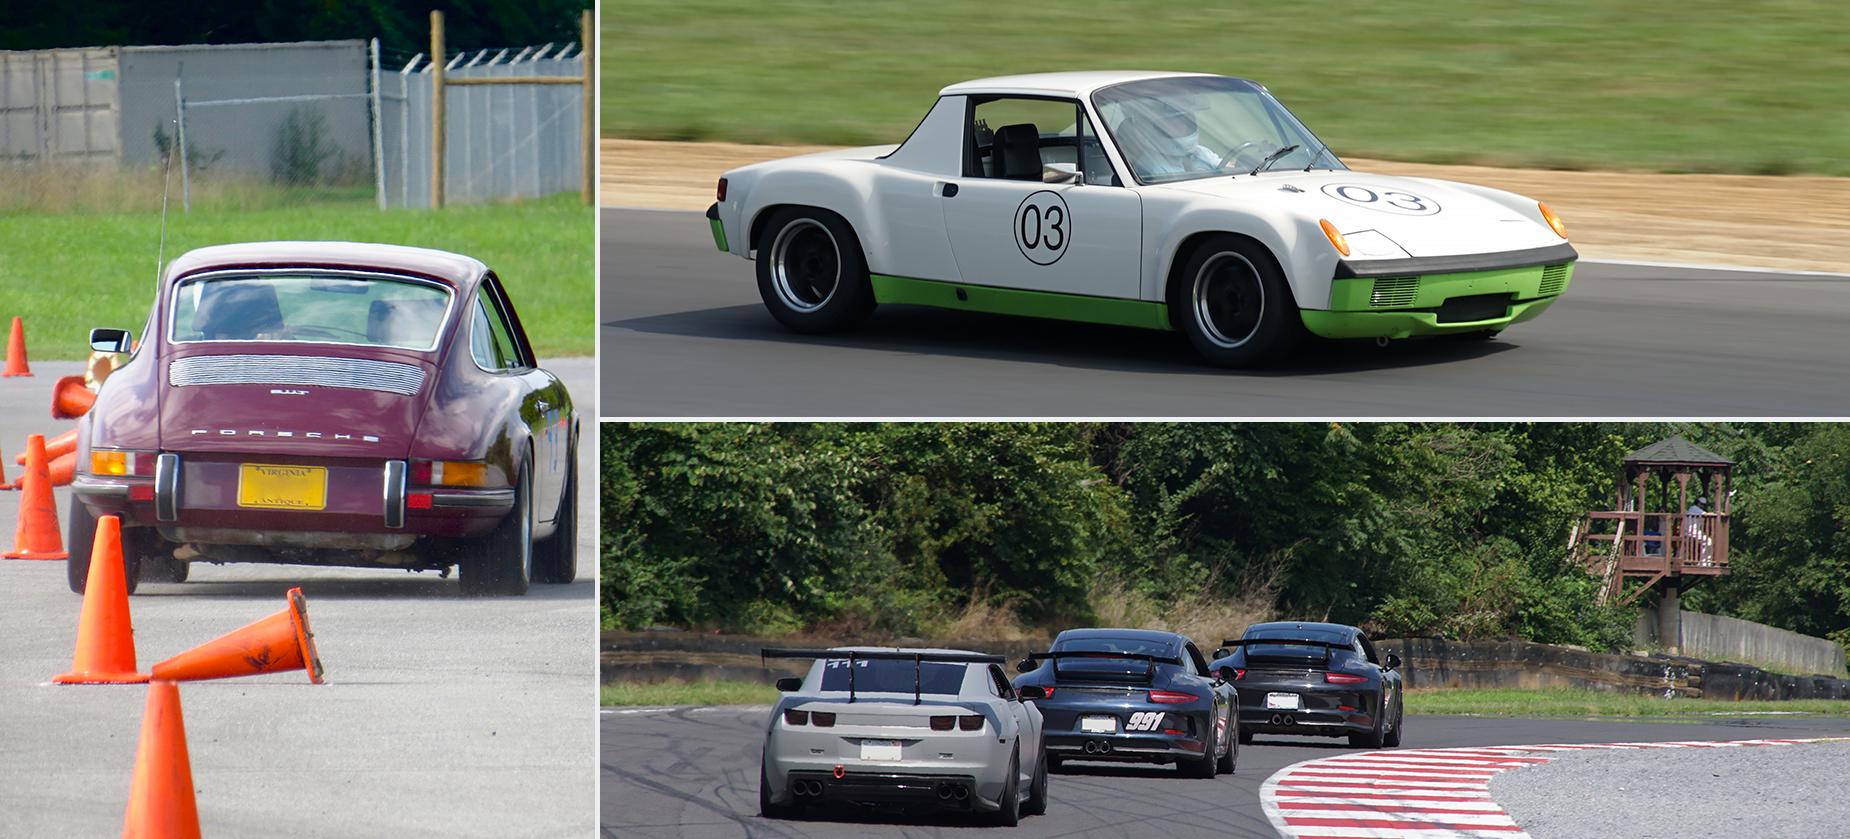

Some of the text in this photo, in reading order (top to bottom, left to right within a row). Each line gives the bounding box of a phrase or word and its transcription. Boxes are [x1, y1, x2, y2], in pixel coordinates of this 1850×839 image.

[1336, 185, 1428, 211] 03
[1021, 203, 1064, 251] 03
[191, 429, 379, 442] PORSCHE
[261, 469, 306, 477] VIRGINIA
[1125, 711, 1165, 731] 991
